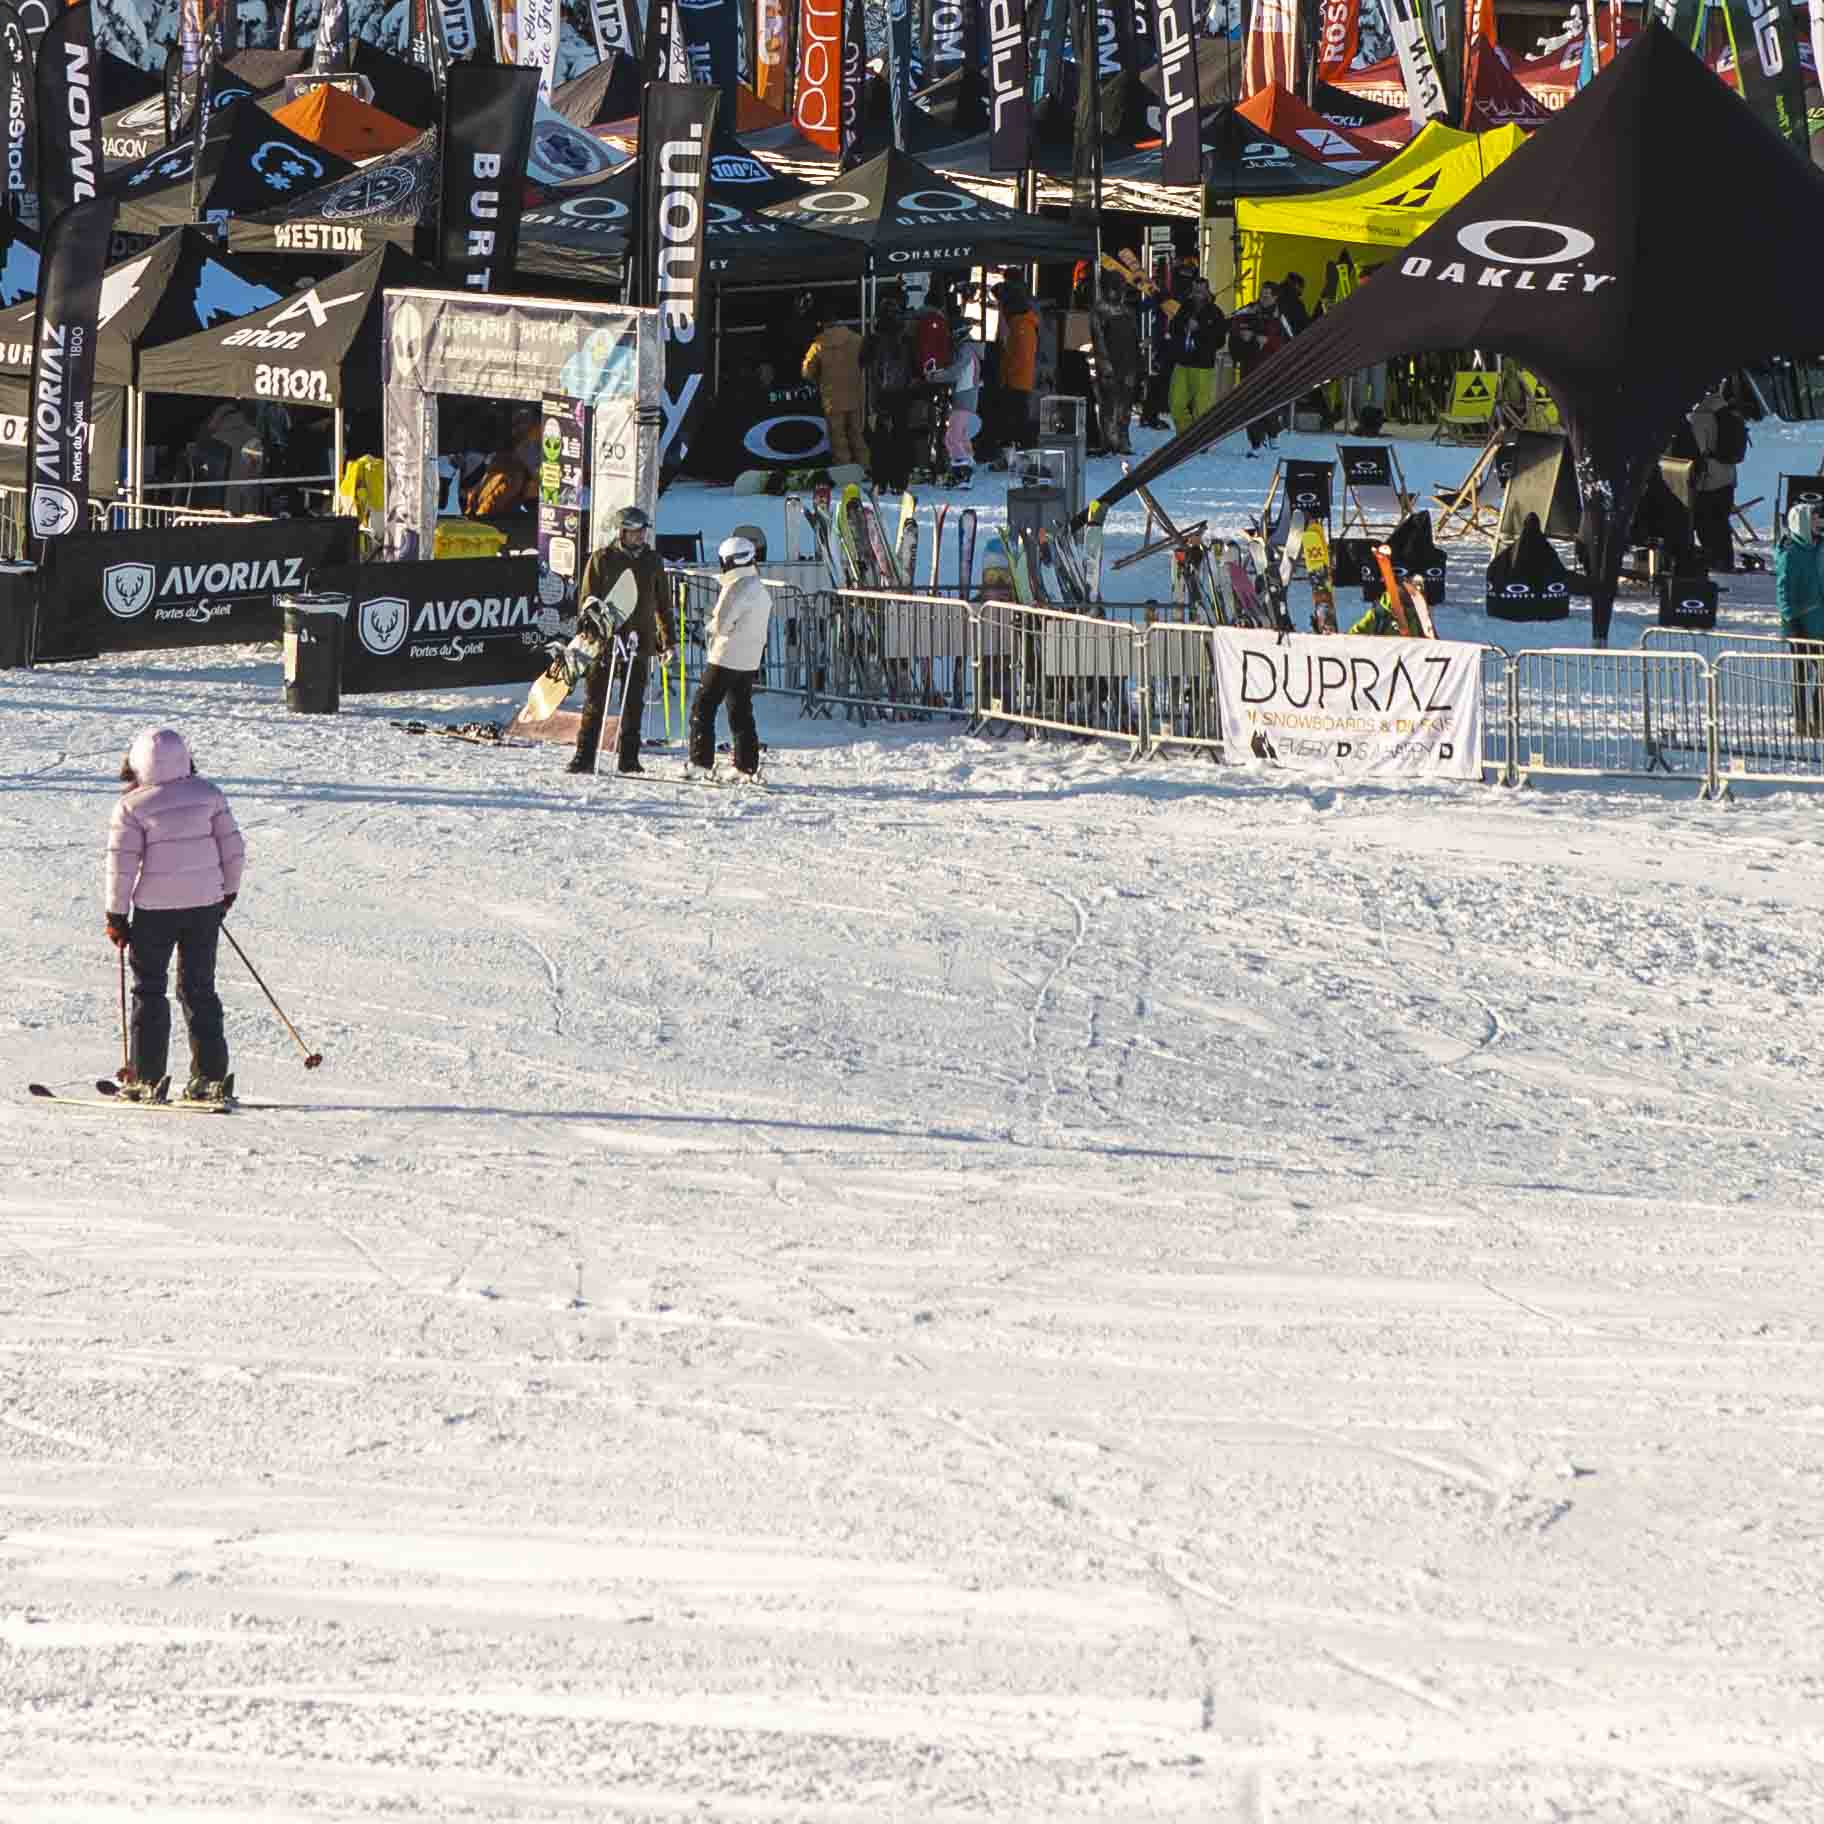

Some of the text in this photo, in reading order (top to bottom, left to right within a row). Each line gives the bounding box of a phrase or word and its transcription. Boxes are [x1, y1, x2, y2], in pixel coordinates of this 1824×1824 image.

[274, 224, 363, 251] WESTON
[1401, 255, 1608, 294] OAKLEY
[69, 326, 84, 358] 1800
[35, 316, 67, 481] AVORIAZ
[254, 363, 333, 403] anon.
[66, 400, 88, 446] Soleil
[71, 454, 83, 483] Portes
[160, 558, 303, 596] AVORIAZ
[154, 597, 232, 624] Portes du Soleil
[410, 635, 486, 663] Portes du Soleil
[1241, 650, 1452, 712] DUPRAZ
[1263, 711, 1376, 731] SNOWBOARDS
